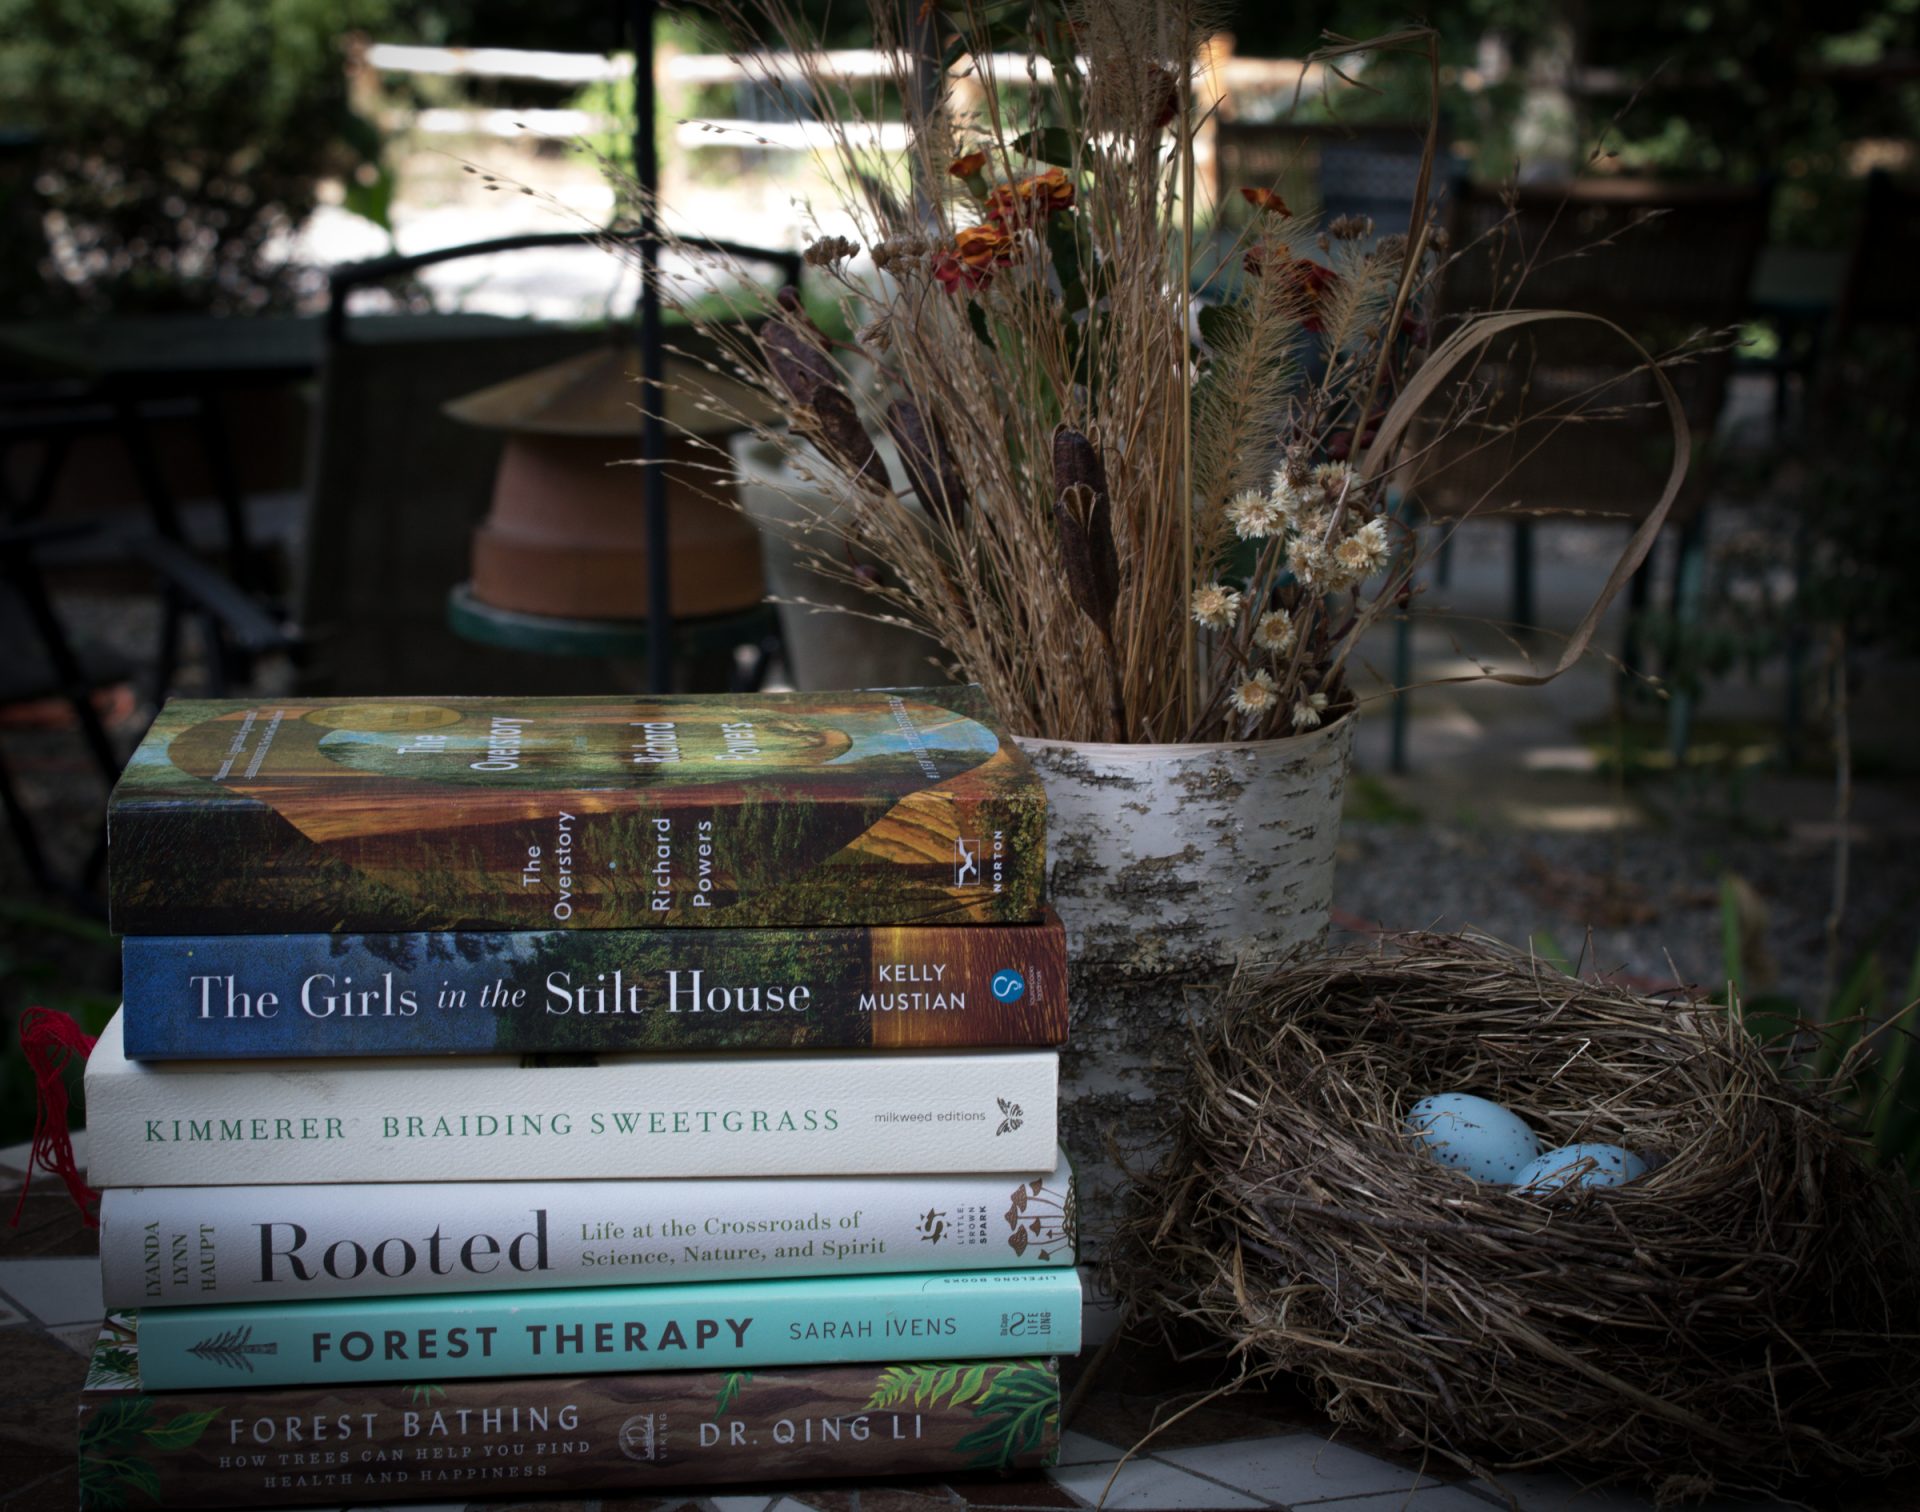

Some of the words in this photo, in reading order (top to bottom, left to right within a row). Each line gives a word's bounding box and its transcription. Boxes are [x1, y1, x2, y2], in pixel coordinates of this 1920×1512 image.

[470, 717, 534, 771] Overstory
[630, 721, 681, 763] Richard
[714, 722, 761, 762] Powers
[523, 845, 541, 887] The
[554, 811, 576, 920] Overstory
[652, 817, 671, 911] Richard
[694, 820, 712, 907] Powers
[993, 830, 1002, 893] NORTON
[189, 975, 279, 1019] The
[301, 972, 418, 1017] Girls
[437, 982, 467, 1008] in
[479, 979, 527, 1008] the
[545, 970, 643, 1015] Stilt
[665, 969, 811, 1013] House
[879, 964, 947, 983] KELLY
[858, 992, 966, 1012] MUSTIAN
[144, 1116, 346, 1143] KIMMERER
[382, 1112, 573, 1139] BRAIDING
[590, 1108, 840, 1135] SWEETGRASS
[874, 1110, 933, 1123] milkweed
[937, 1109, 986, 1122] editions
[581, 1222, 627, 1241] Life
[632, 1222, 654, 1239] at
[659, 1218, 696, 1238] the
[703, 1212, 831, 1236] Crossroads
[839, 1210, 863, 1230] of
[969, 1205, 977, 1244] BROWN
[979, 1204, 987, 1245] SPARK
[144, 1220, 162, 1297] LYANDA
[172, 1233, 188, 1286] LYNN
[200, 1224, 216, 1291] HAUPT
[251, 1208, 556, 1283] Rooted
[581, 1247, 675, 1268] Science,
[683, 1243, 767, 1264] Nature,
[775, 1240, 814, 1261] and
[822, 1237, 887, 1260] Spirit
[312, 1326, 498, 1363] FOREST
[526, 1317, 755, 1356] THERAPY
[789, 1320, 873, 1341] SARAH
[885, 1317, 958, 1338] IVENS
[1027, 1312, 1038, 1335] LIFE
[1040, 1311, 1051, 1335] LONG
[230, 1413, 378, 1445] FOREST
[403, 1404, 580, 1438] BATHING
[659, 1412, 668, 1460] VIKING
[700, 1420, 757, 1448] DR.
[773, 1416, 871, 1445] QING
[893, 1414, 923, 1439] LI
[220, 1455, 267, 1469] HOW
[280, 1451, 350, 1466] TREES
[361, 1448, 405, 1463] CAN
[416, 1446, 473, 1460] HELP
[484, 1443, 526, 1457] YOU
[537, 1441, 590, 1455] FIND
[264, 1471, 353, 1488] HEALTH
[364, 1469, 408, 1484] AND
[420, 1464, 547, 1482] HAPPINESS
